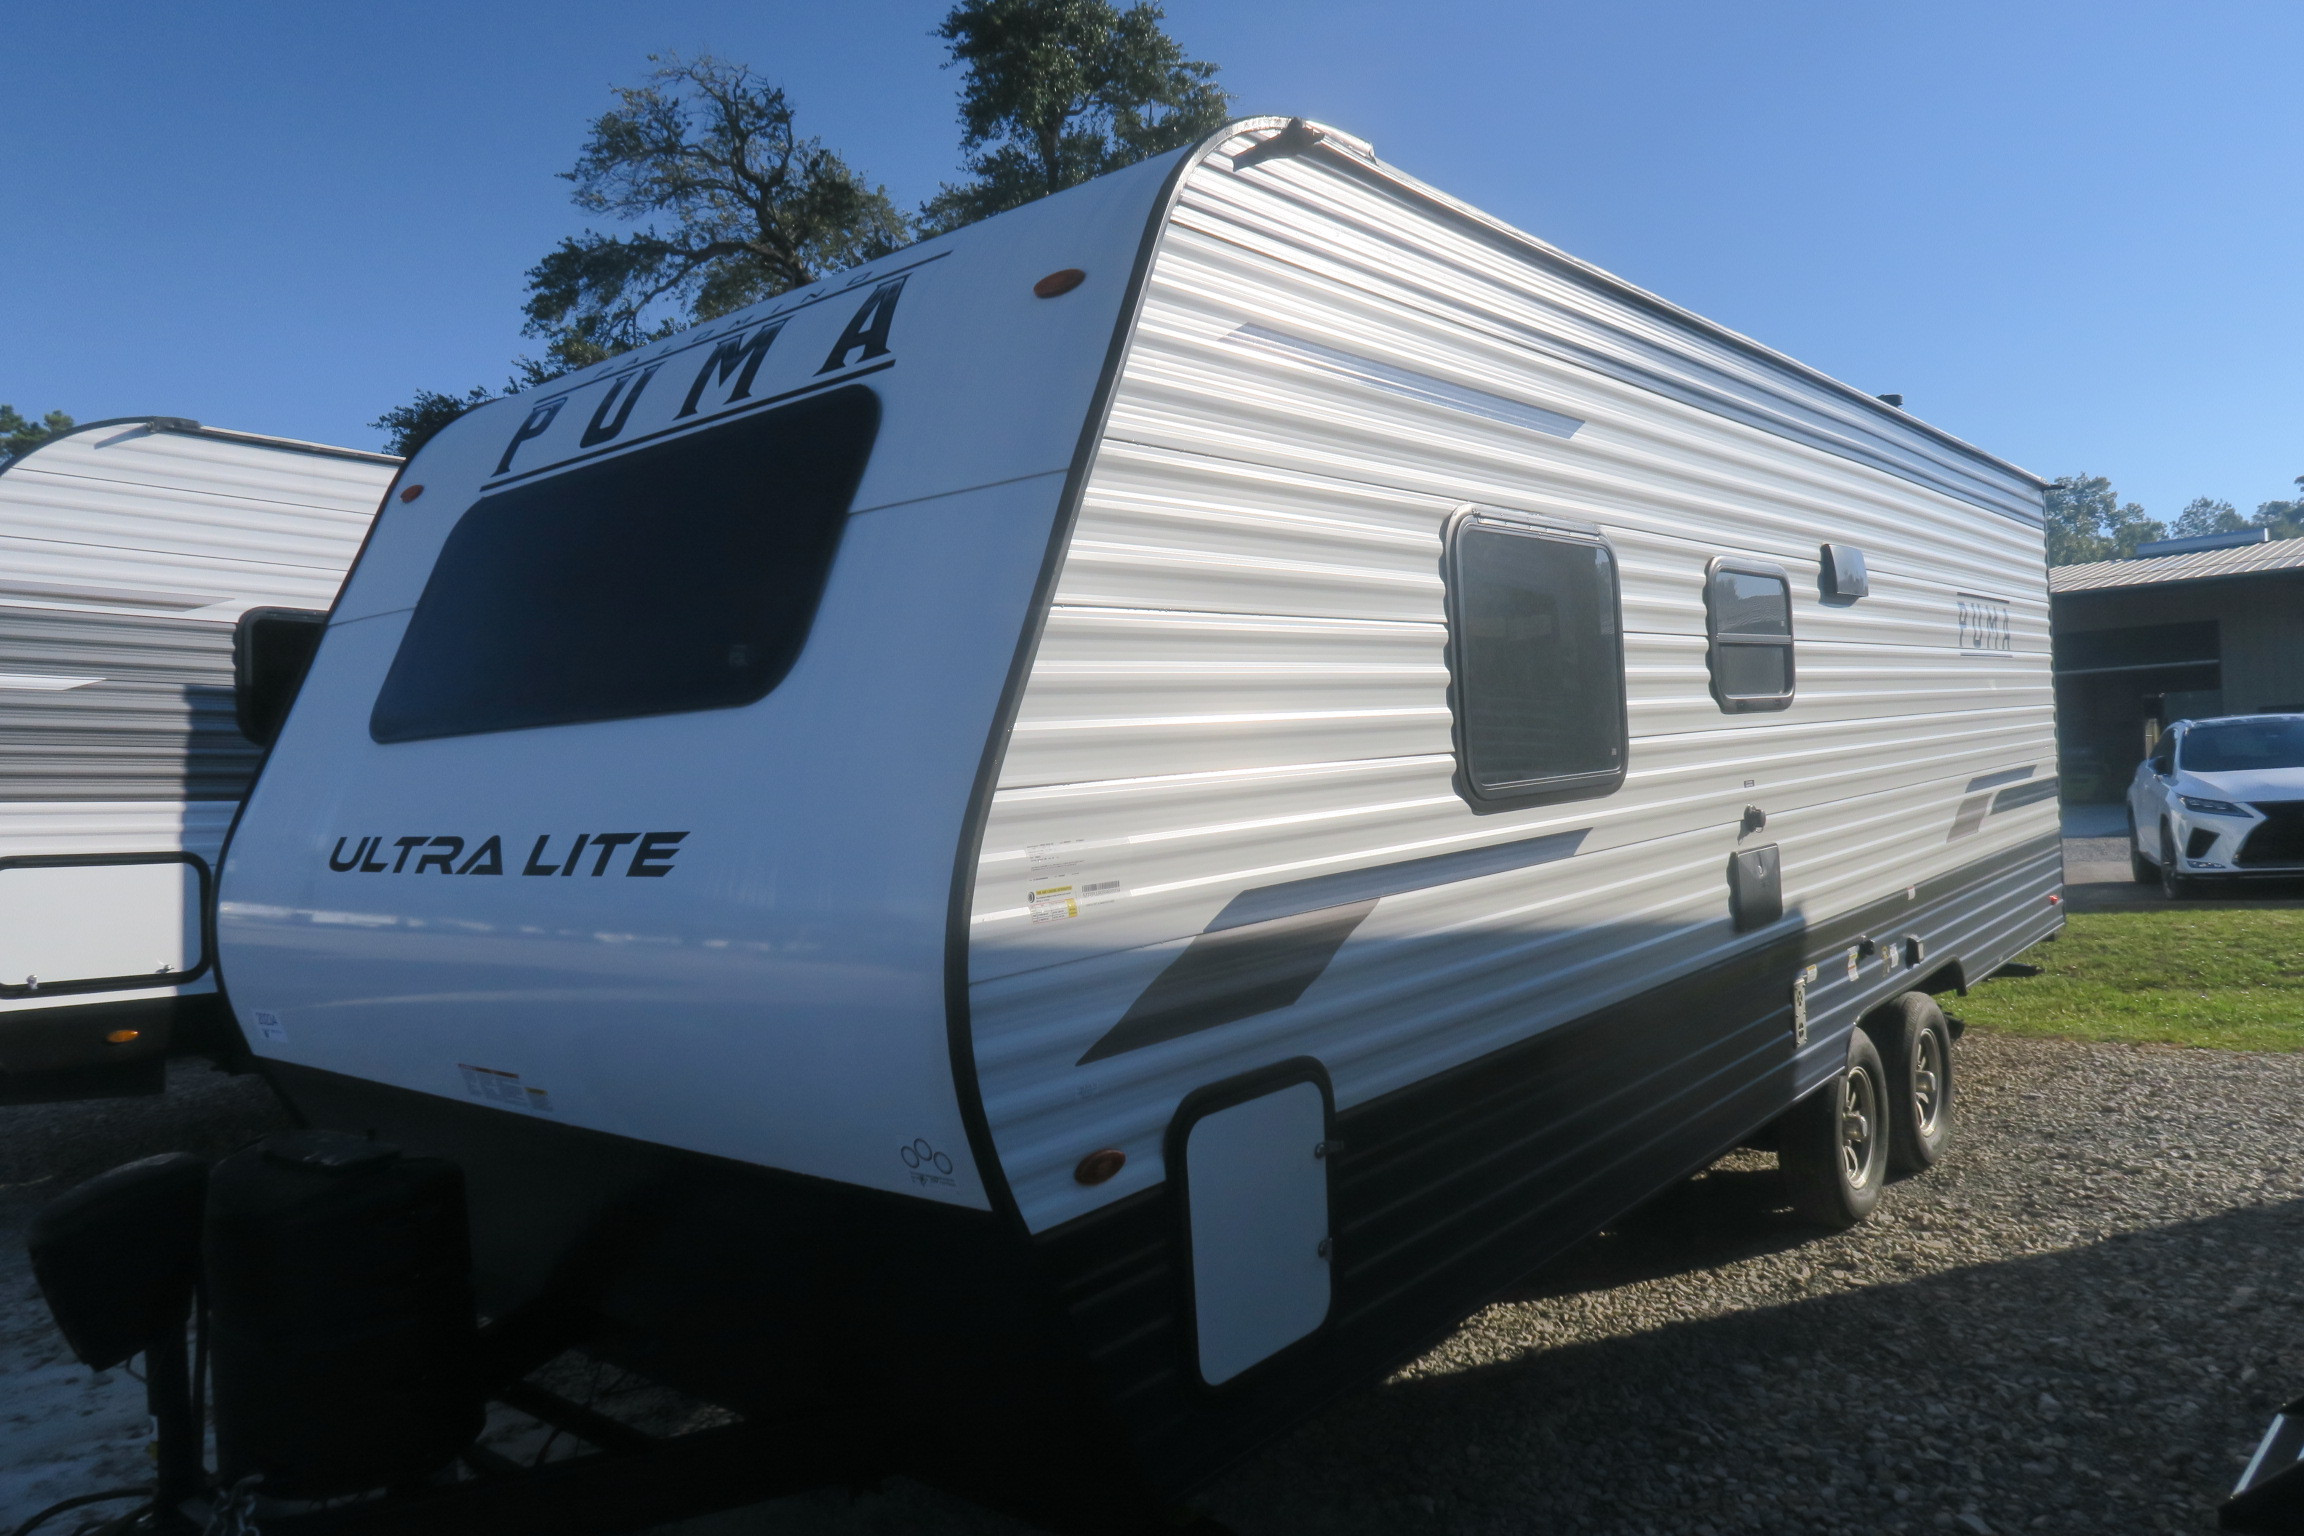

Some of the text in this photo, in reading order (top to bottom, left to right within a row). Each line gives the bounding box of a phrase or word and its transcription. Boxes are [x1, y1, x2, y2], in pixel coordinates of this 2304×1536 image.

[490, 272, 914, 478] PUMA
[1956, 600, 2011, 650] PUMA
[329, 831, 691, 877] ULTRA LITE
